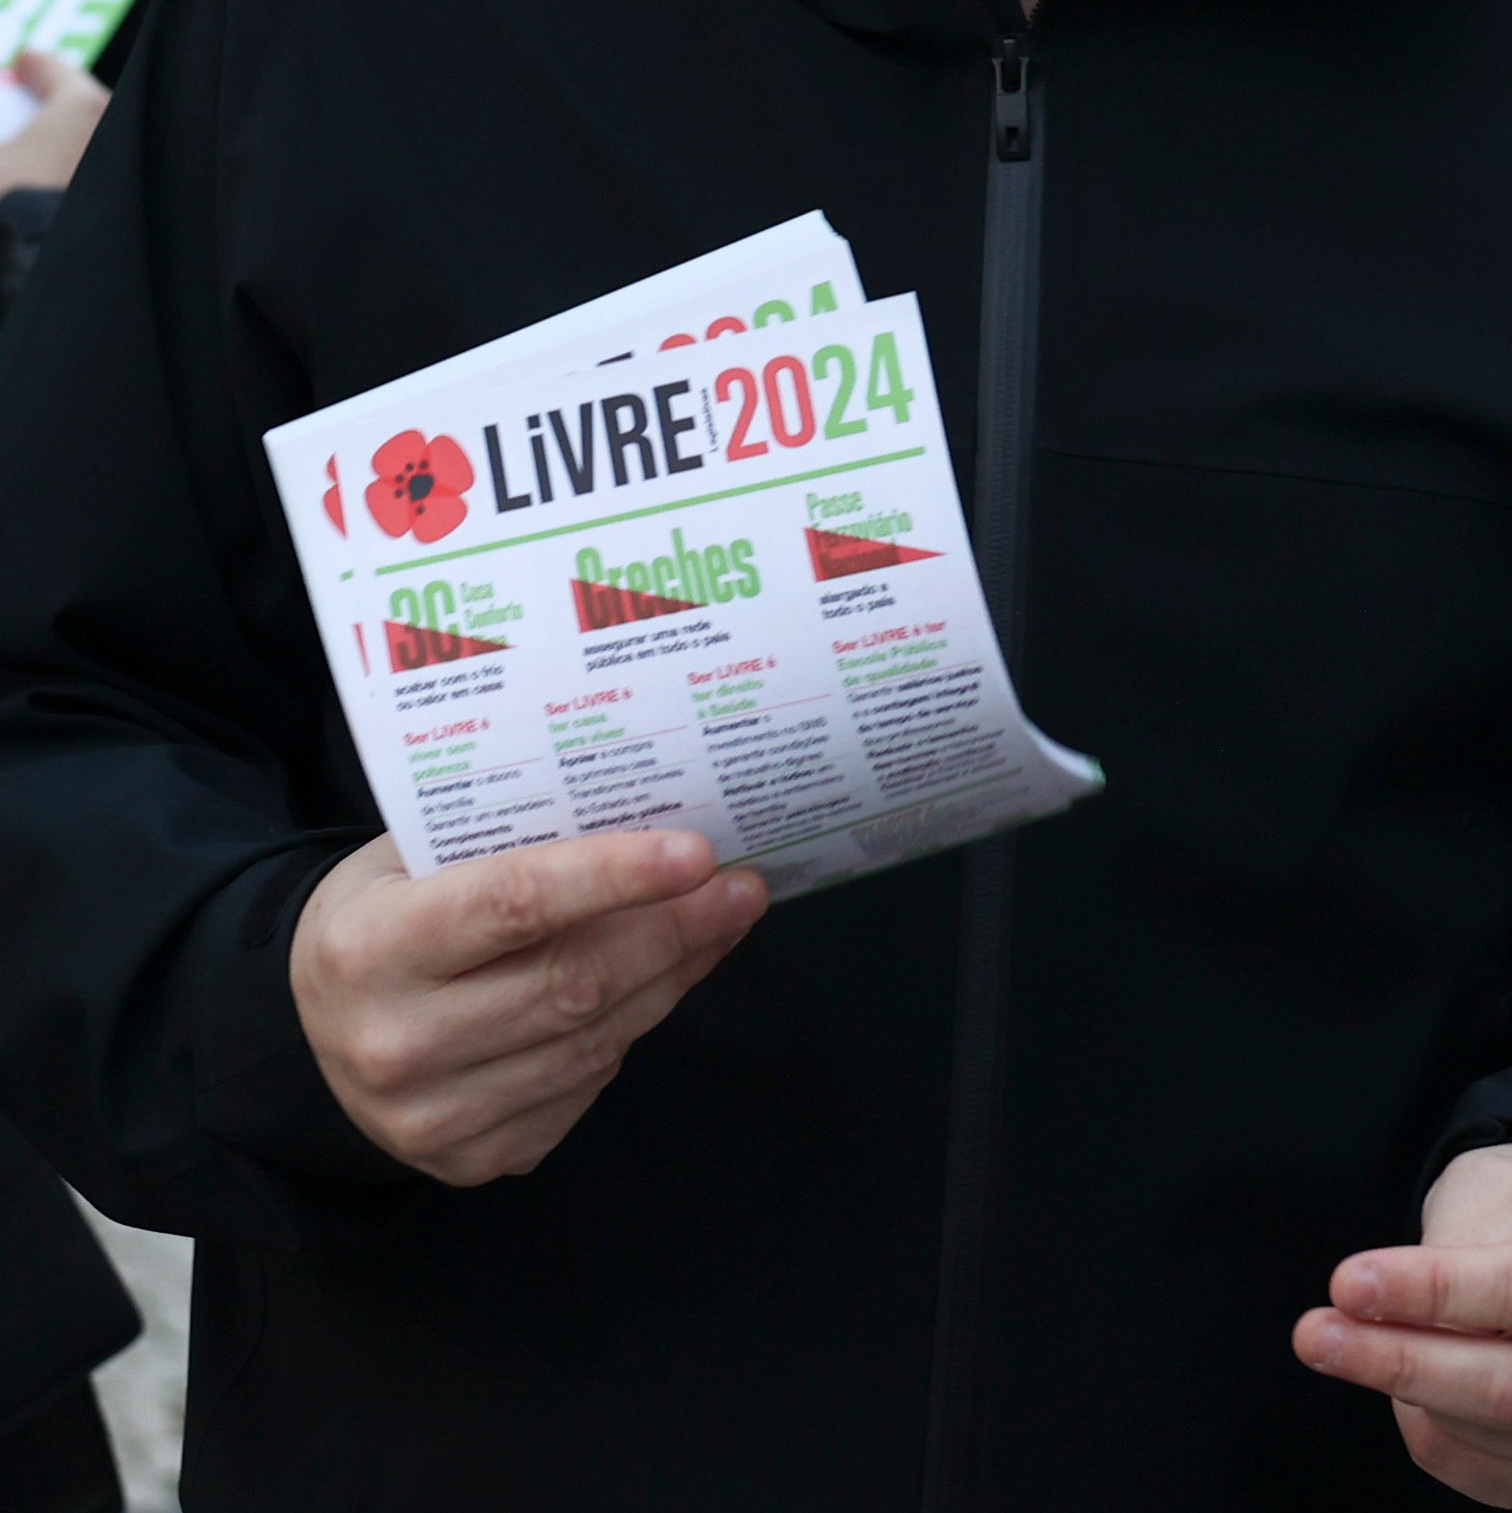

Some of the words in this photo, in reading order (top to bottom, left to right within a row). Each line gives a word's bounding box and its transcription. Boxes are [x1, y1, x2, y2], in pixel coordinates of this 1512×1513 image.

[714, 331, 915, 462] 2024
[806, 491, 863, 520] Passe
[389, 579, 460, 669] 3C
[575, 527, 761, 628] Creches
